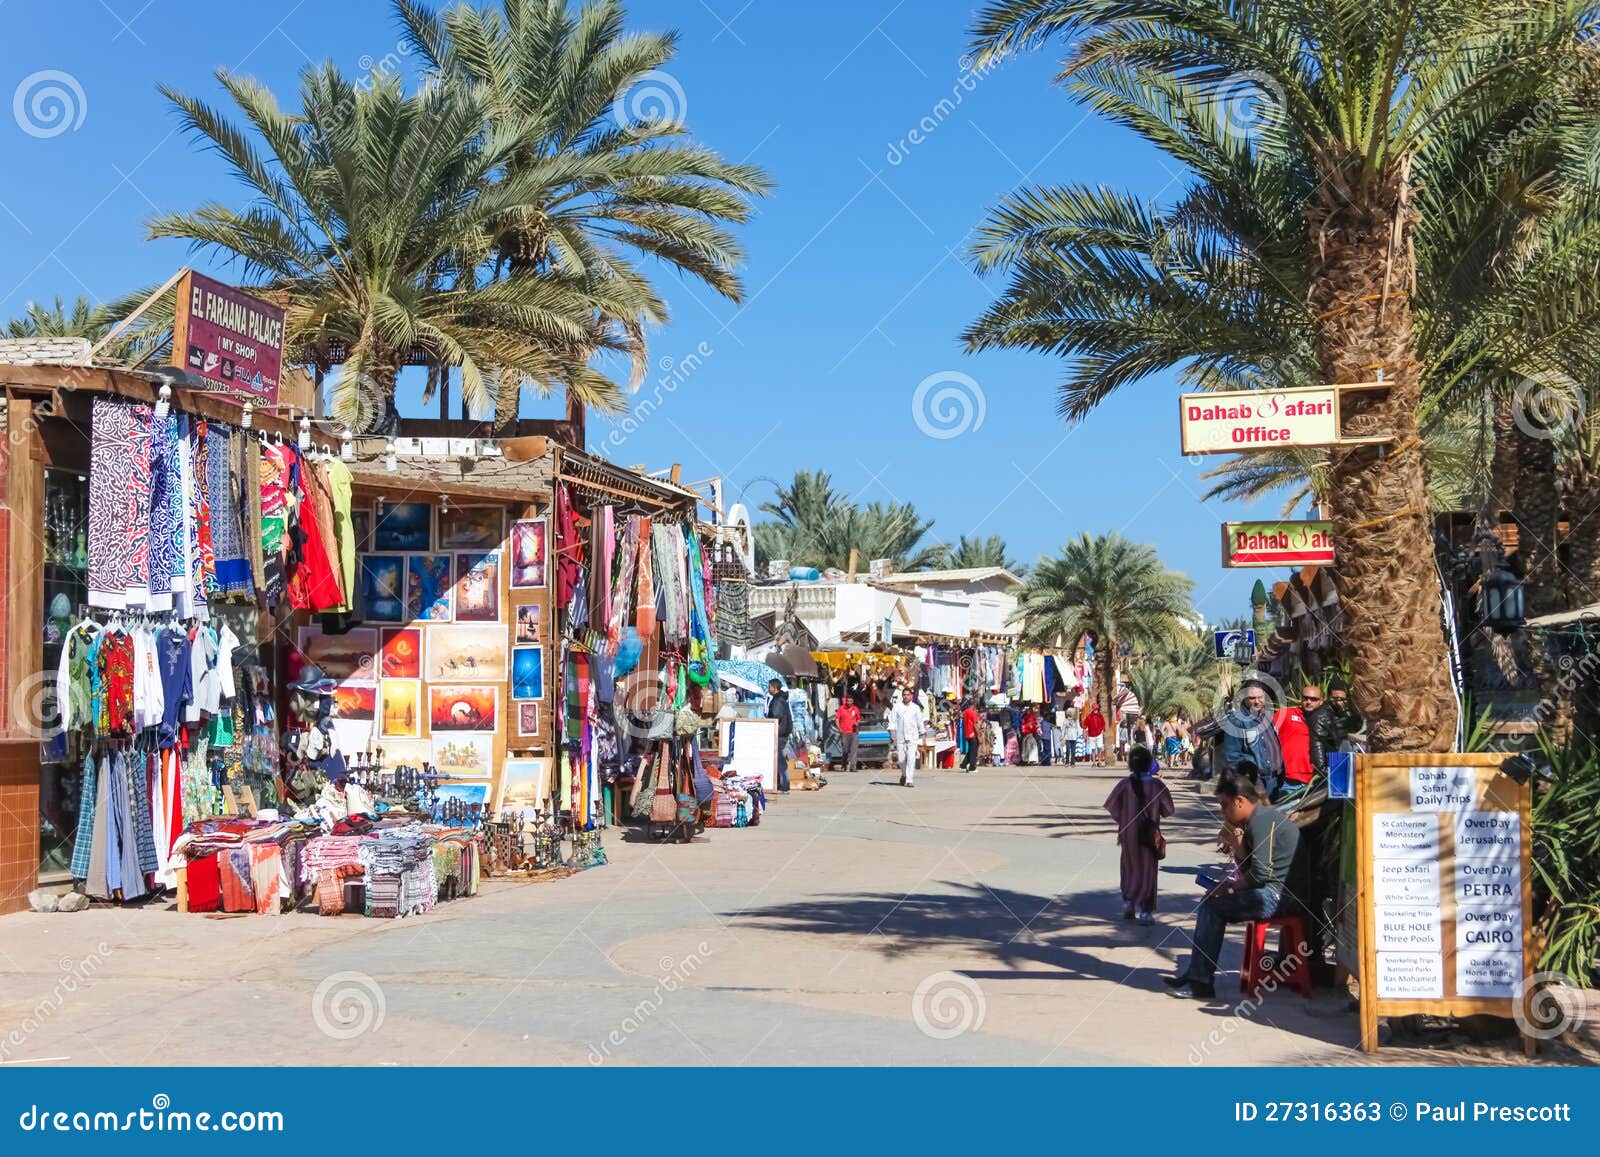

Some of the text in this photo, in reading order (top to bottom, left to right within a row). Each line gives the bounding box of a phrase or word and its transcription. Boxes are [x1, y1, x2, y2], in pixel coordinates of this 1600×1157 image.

[191, 286, 204, 318] EL
[205, 291, 247, 336] FARAANA
[248, 310, 281, 349] PALACE
[1188, 404, 1252, 421] Dahab
[1231, 427, 1291, 443] Office
[1237, 531, 1289, 550] Dahab
[1418, 772, 1448, 780] Dahab
[1422, 784, 1448, 793] Safari
[1416, 794, 1471, 805] Daily Trips
[1391, 820, 1428, 829] Catherine
[1464, 818, 1511, 829] OverDay
[1385, 831, 1426, 839] Monastery
[1460, 835, 1514, 845] Jerusalem
[1382, 865, 1430, 875] Jeep Safari
[1463, 865, 1513, 876] Over Day
[1463, 883, 1513, 897] PETRA
[1465, 912, 1514, 922] Over Day
[1383, 923, 1432, 931] BLUE HOLE
[1383, 935, 1435, 943] Three Pools
[1465, 930, 1514, 943] CAIRO
[1465, 969, 1488, 977] Horse
